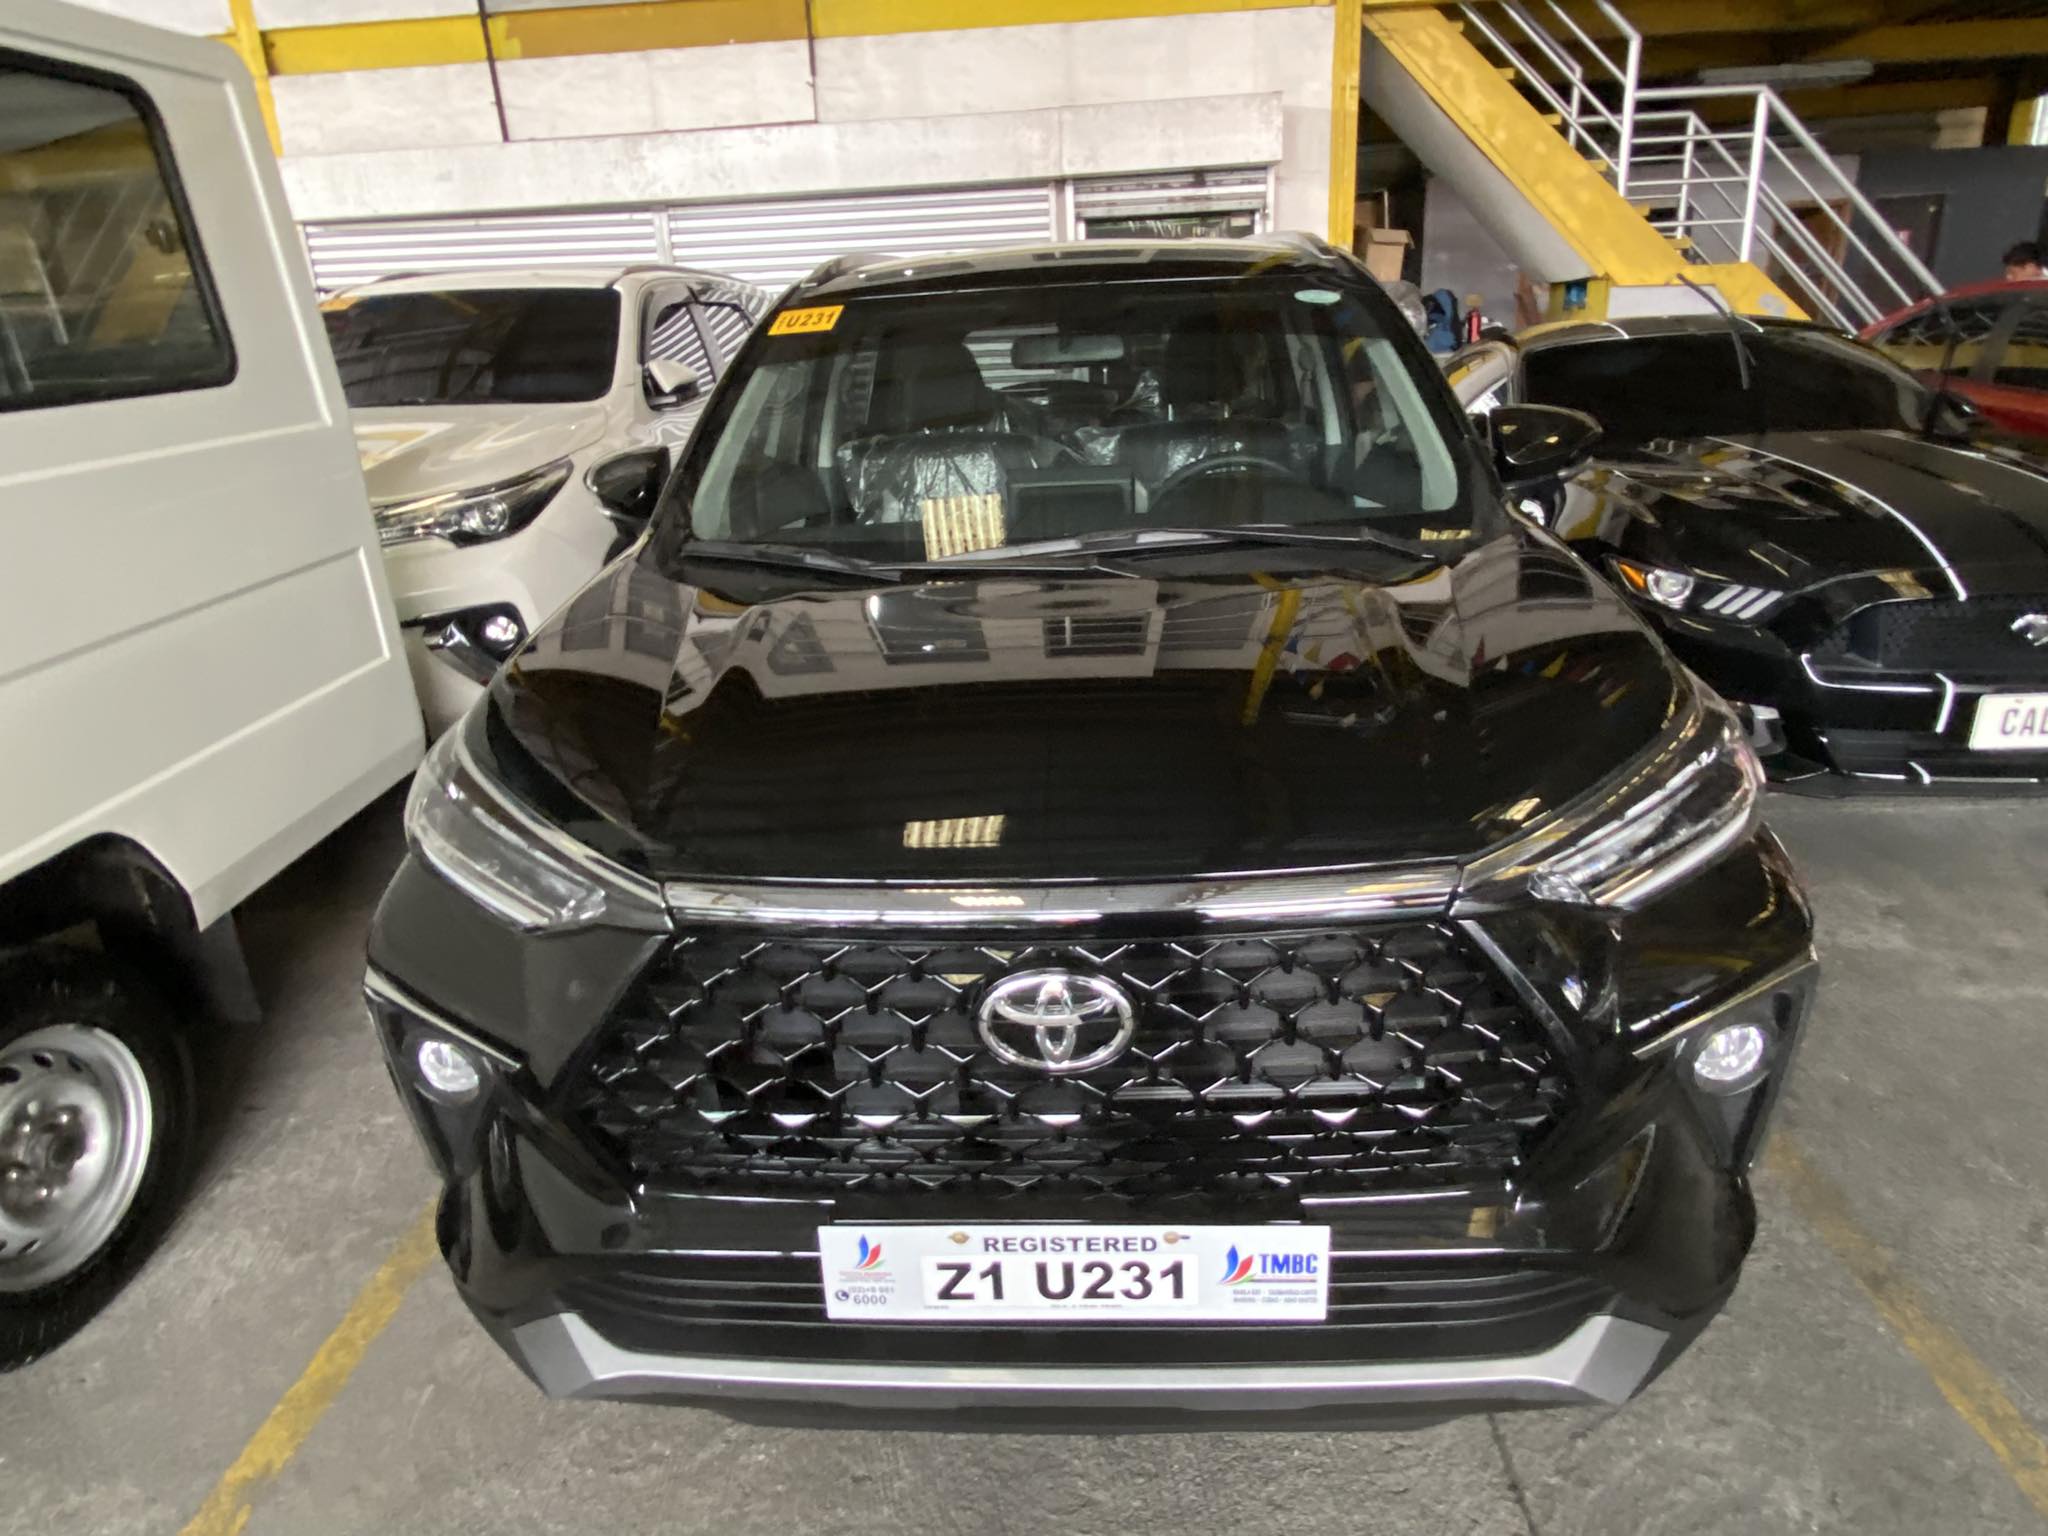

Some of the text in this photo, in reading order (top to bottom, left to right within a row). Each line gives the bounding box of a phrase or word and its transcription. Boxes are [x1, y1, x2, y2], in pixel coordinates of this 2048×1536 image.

[786, 310, 836, 328] U231
[983, 1236, 1158, 1253] REGISTERED
[1259, 1253, 1318, 1274] TMBC
[936, 1260, 1184, 1301] Z1 U231
[853, 1294, 887, 1305] 6000
